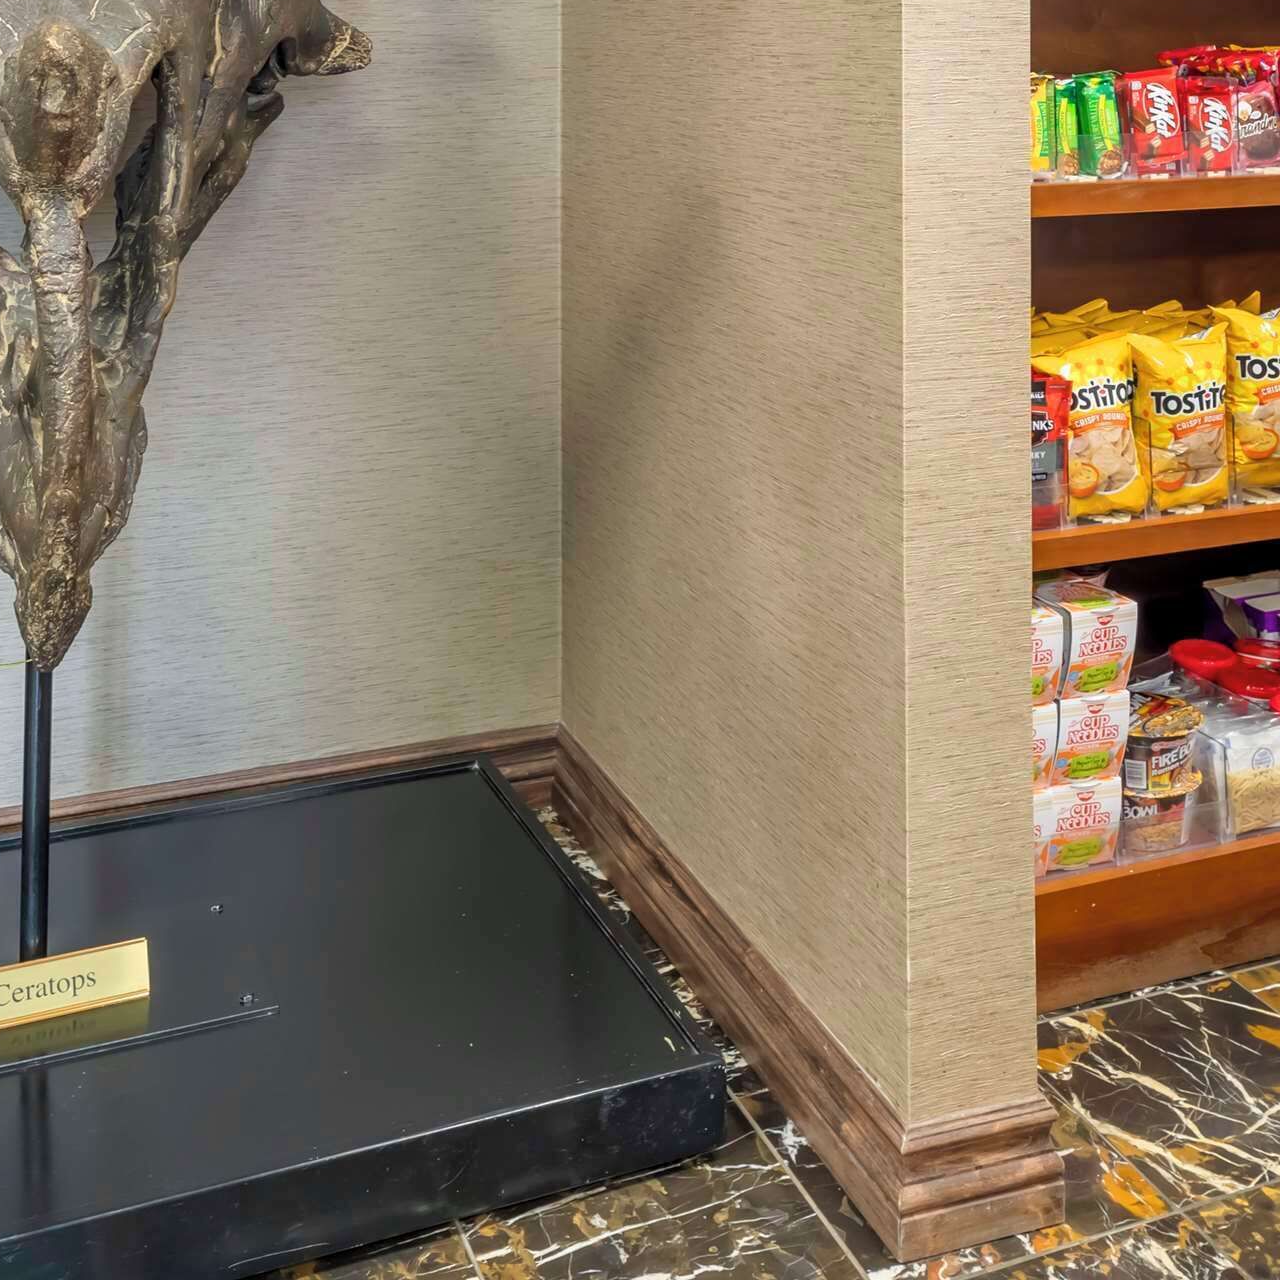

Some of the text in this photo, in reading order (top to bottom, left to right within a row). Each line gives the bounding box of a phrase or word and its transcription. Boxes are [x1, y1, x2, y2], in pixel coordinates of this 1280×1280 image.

[1075, 414, 1101, 428] CRISPY
[1175, 418, 1202, 431] CRISPY
[1091, 626, 1119, 641] CUP
[1078, 635, 1128, 658] NOODLES
[1081, 714, 1111, 730] CUP
[1066, 724, 1120, 745] NOODLES
[1151, 747, 1180, 769] FIRE
[1071, 802, 1102, 818] CUP
[1056, 812, 1111, 832] NOODLES
